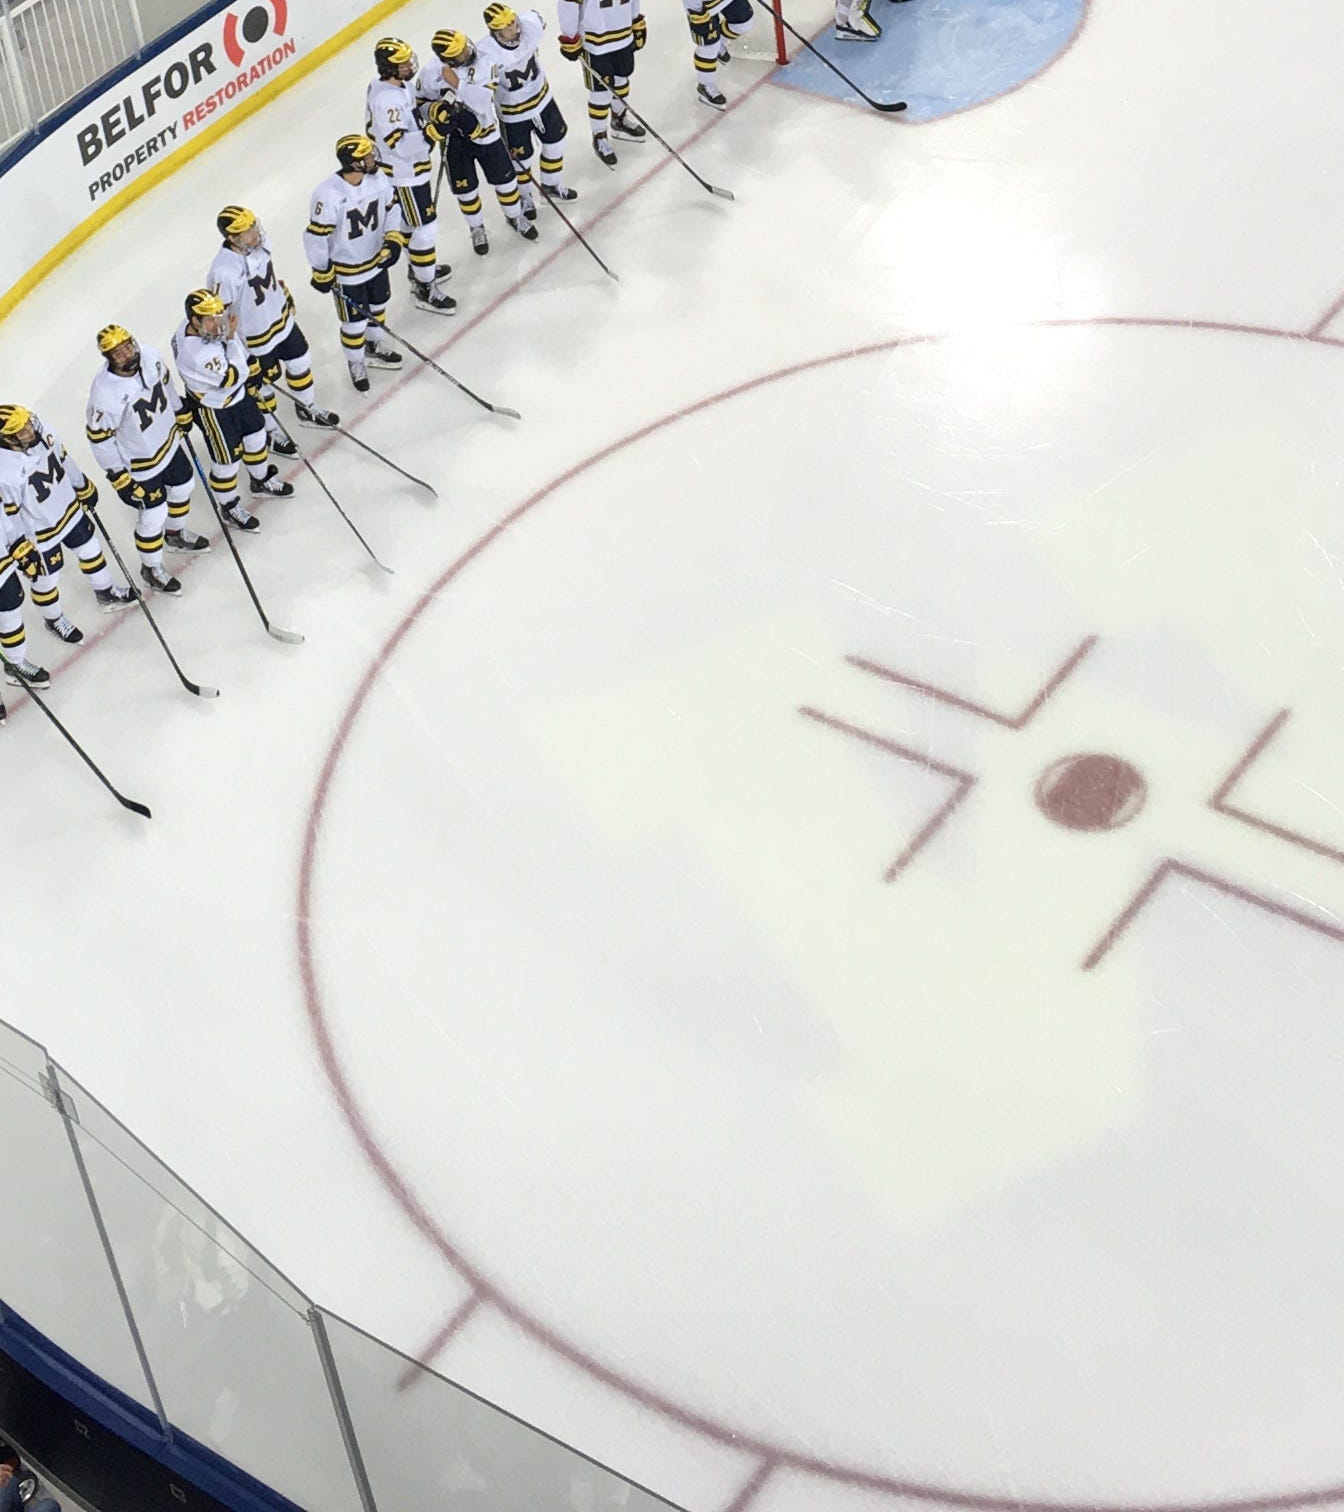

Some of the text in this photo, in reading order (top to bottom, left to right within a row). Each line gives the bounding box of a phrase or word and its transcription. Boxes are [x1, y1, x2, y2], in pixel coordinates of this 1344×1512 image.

[505, 58, 539, 92] M
[75, 40, 218, 167] BELFOR
[87, 37, 297, 201] PROPERTY RESTORATION
[386, 108, 401, 123] 22
[314, 201, 323, 215] 6
[346, 199, 379, 239] M
[248, 261, 277, 305] M
[133, 384, 169, 432] M
[28, 451, 65, 504] M
